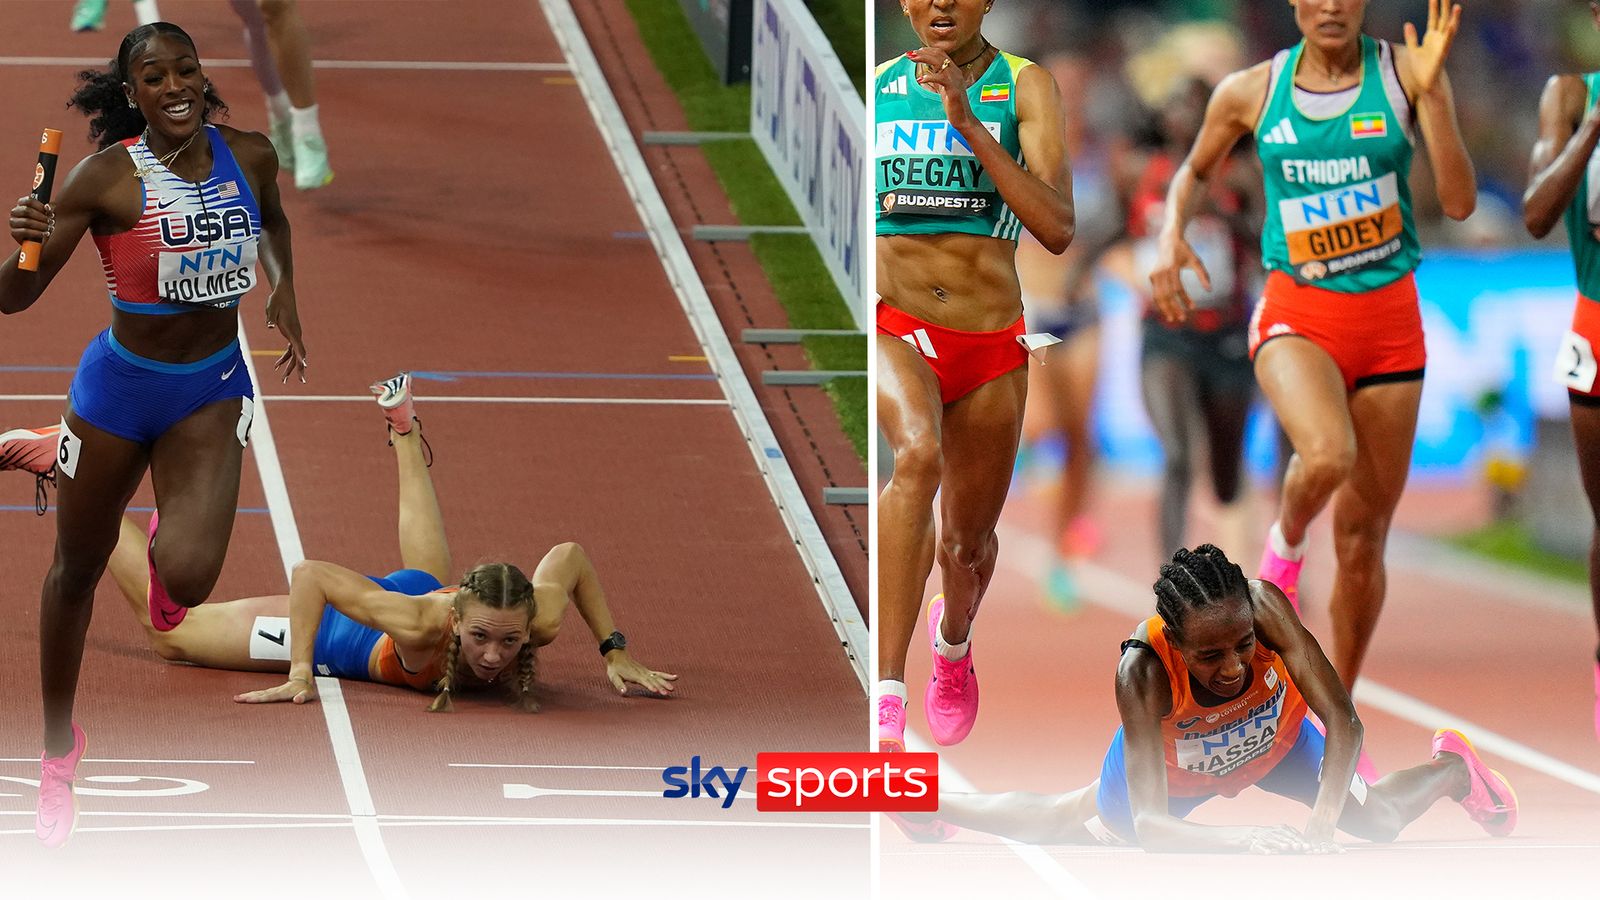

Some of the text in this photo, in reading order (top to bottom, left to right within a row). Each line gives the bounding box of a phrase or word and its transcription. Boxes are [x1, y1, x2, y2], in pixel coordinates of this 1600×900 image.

[892, 121, 973, 154] NTN
[881, 157, 985, 188] TSEGAY
[1281, 155, 1372, 185] ETHIOPIA
[897, 194, 969, 208] BUDAPEST
[1301, 183, 1382, 224] NTN
[159, 205, 251, 248] USA
[1309, 214, 1385, 257] GIDEY
[180, 245, 243, 275] NTN
[164, 266, 251, 301] HOLMES
[59, 435, 71, 465] 6
[258, 627, 287, 646] 7
[1202, 704, 1278, 755] NTN
